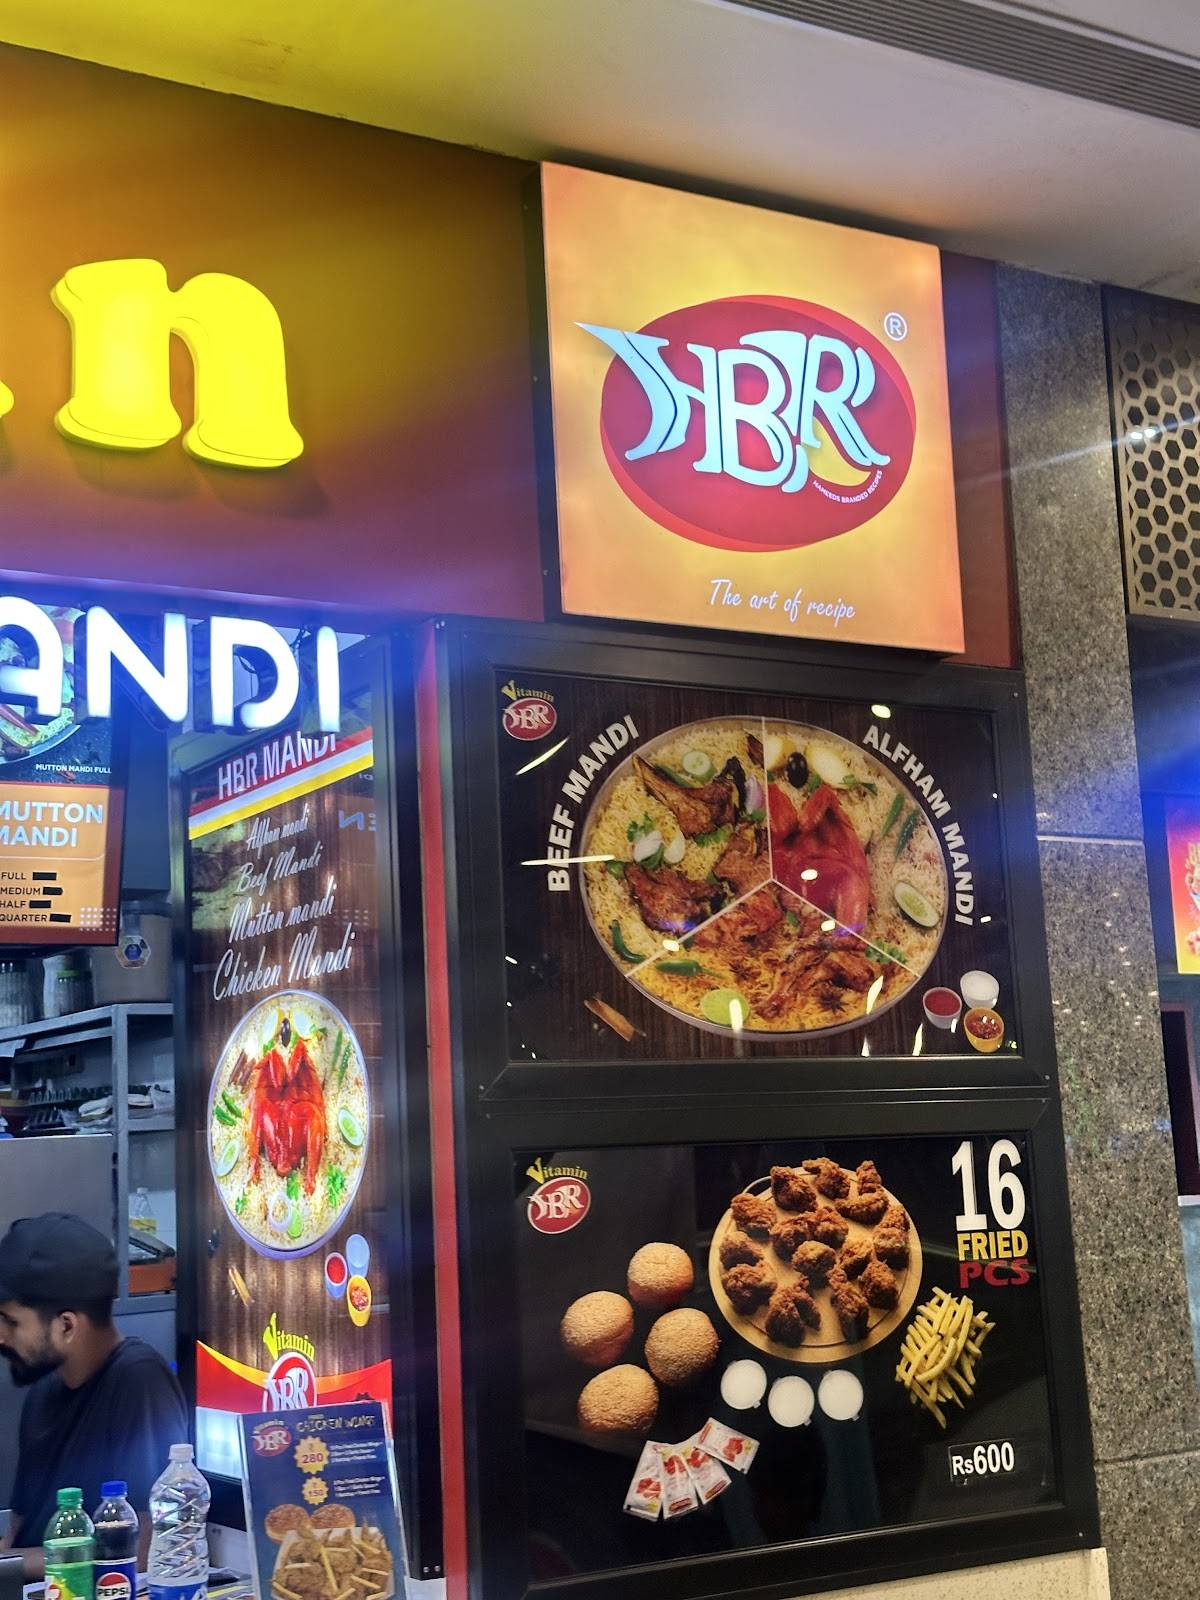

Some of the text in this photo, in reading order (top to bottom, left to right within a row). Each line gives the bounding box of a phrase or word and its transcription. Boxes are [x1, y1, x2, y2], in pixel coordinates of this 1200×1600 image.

[574, 322, 890, 493] HBR
[841, 492, 869, 503] BRANDED
[710, 579, 855, 628] The art of recipe
[501, 680, 555, 701] Vitamin
[35, 763, 112, 774] MUTTON MANDI FULL
[218, 752, 259, 800] HBR
[547, 714, 639, 891] BEEF MANDI
[862, 724, 976, 926] ALFHAM MANDI
[1, 871, 27, 880] FULL
[235, 840, 323, 896] Beef Mandi
[0, 886, 41, 895] MEDIUM
[0, 900, 27, 908] HALF
[0, 913, 48, 922] QUARTER
[228, 897, 285, 943] Mutton
[213, 922, 356, 1000] Chicken Mandi
[526, 1157, 588, 1184] Vitamin
[952, 1138, 1026, 1231] 16
[957, 1230, 1029, 1261] FRIED
[959, 1258, 1031, 1289] PCS
[263, 1312, 315, 1362] Vitamin
[302, 1453, 324, 1463] 280
[952, 1442, 1015, 1475] Rs600
